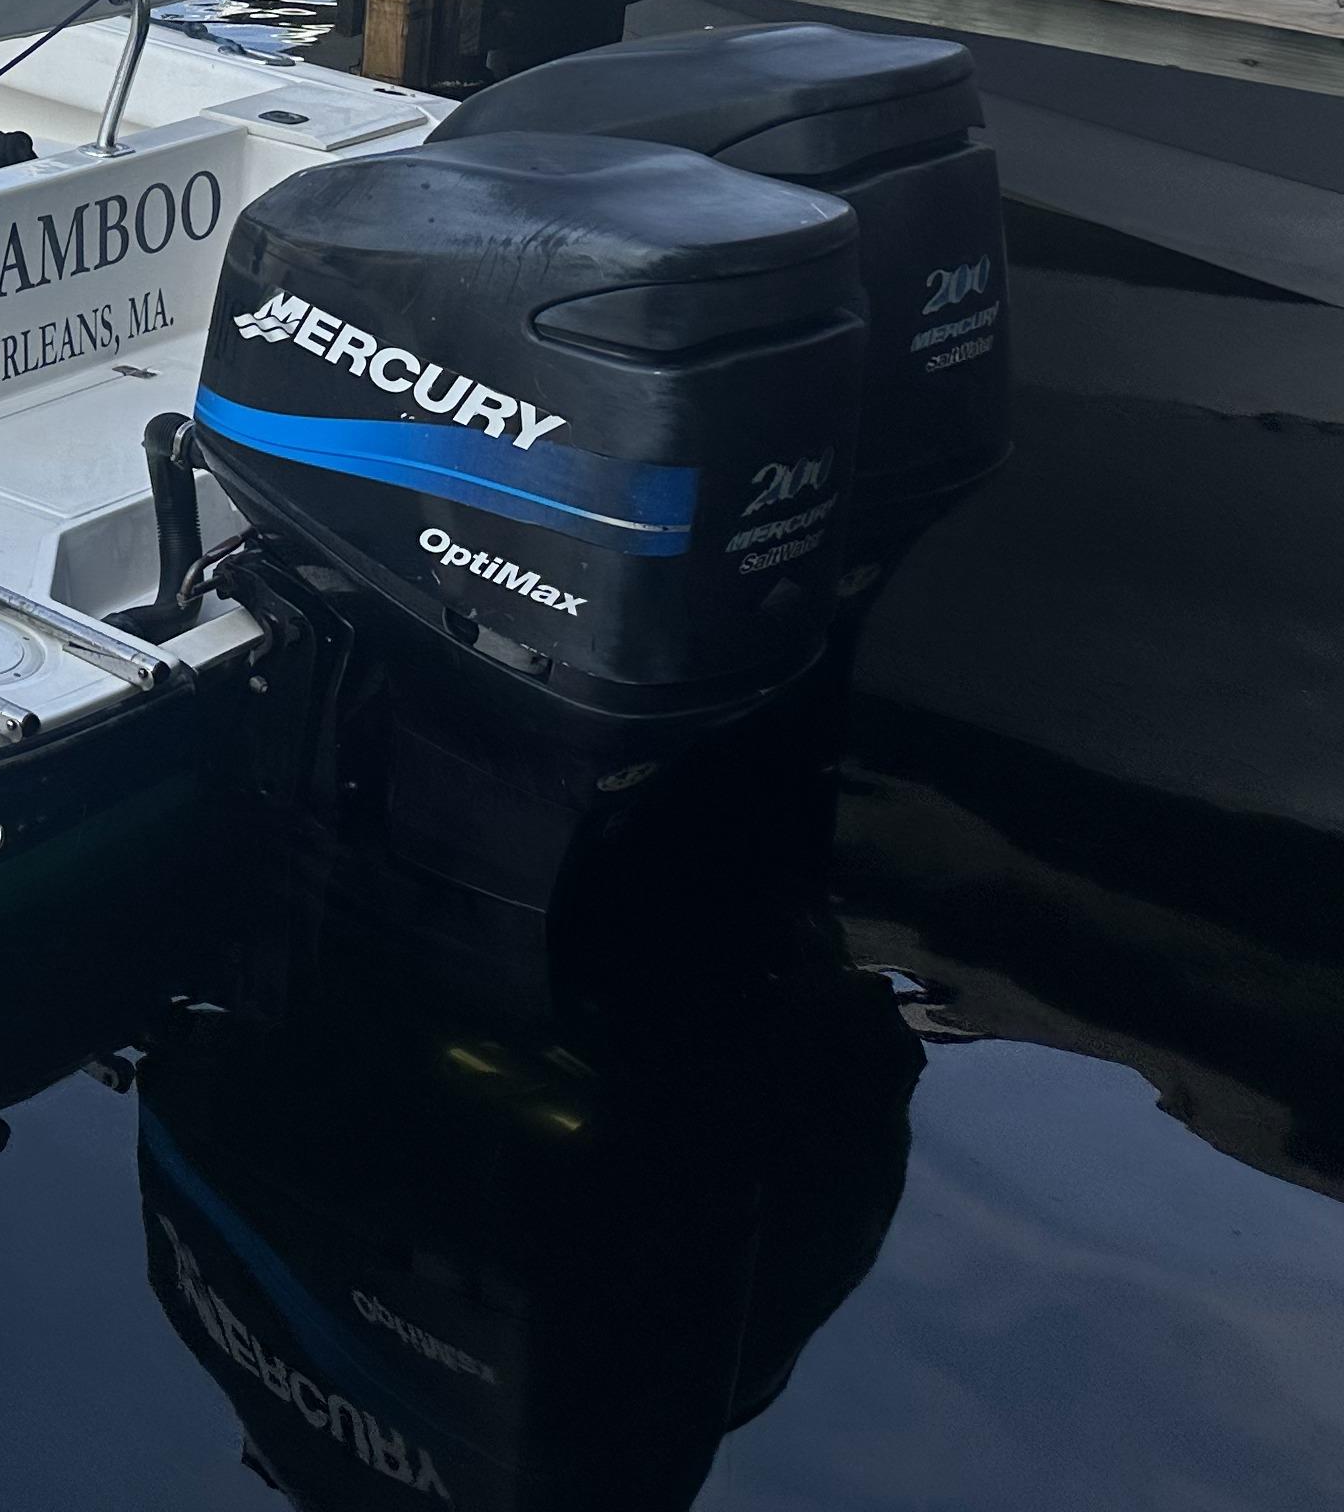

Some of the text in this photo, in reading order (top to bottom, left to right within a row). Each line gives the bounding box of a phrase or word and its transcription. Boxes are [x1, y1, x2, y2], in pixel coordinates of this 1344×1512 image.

[127, 288, 175, 335] MA.
[921, 254, 991, 316] 200
[234, 292, 567, 451] MERCURY
[740, 445, 835, 518] 200
[419, 528, 588, 617] OptiMax
